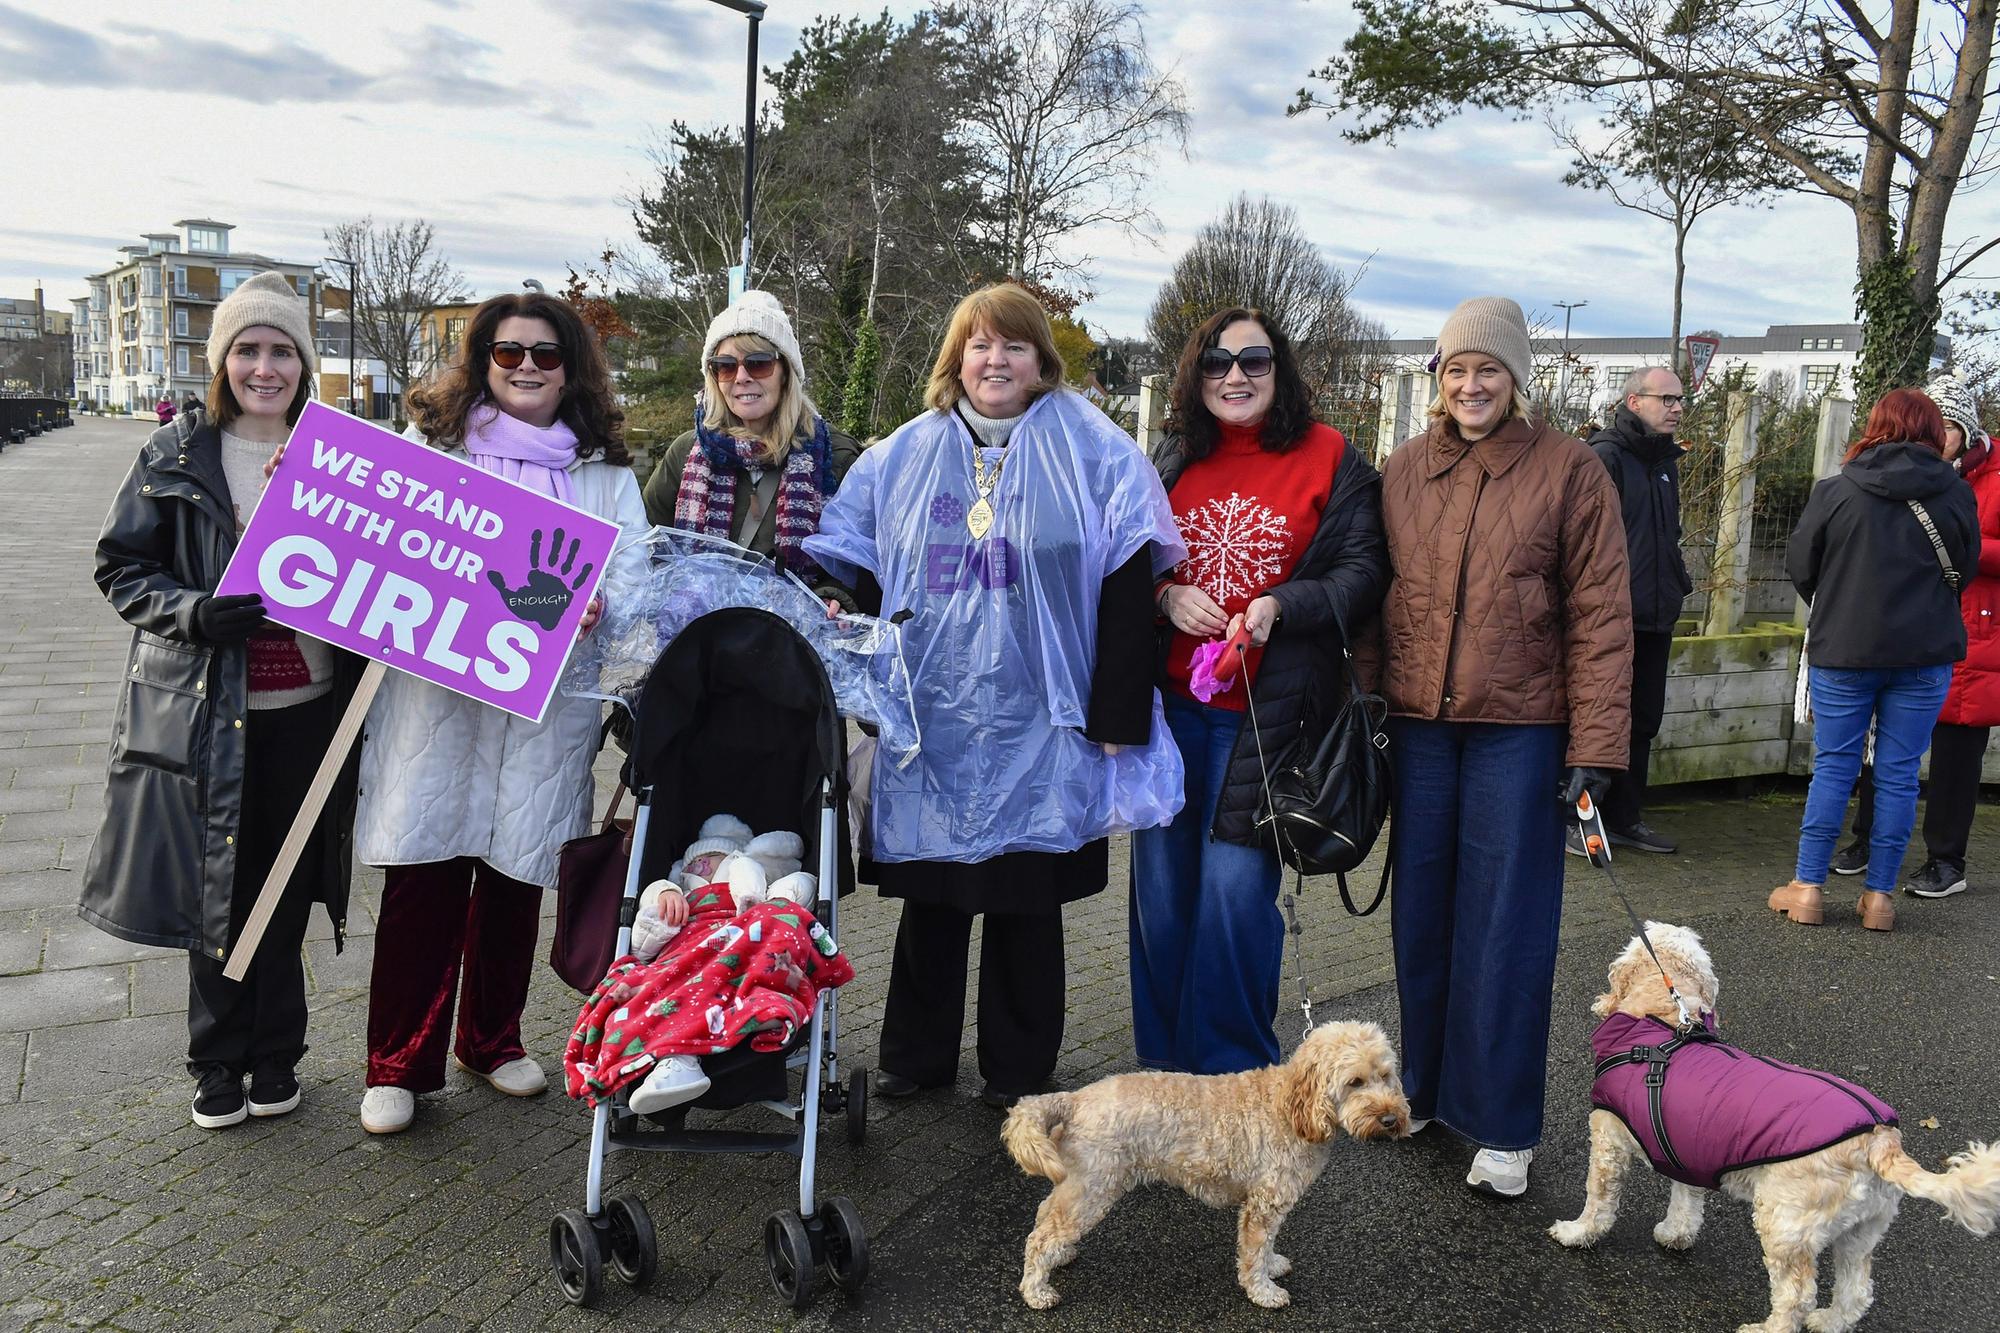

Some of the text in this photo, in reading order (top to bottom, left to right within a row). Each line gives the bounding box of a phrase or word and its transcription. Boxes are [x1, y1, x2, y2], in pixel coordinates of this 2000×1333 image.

[1692, 343, 1711, 357] GIVE
[311, 438, 504, 540] WE STAND
[291, 480, 484, 584] WITH OUR
[927, 537, 1021, 595] END
[257, 534, 540, 692] GIRLS
[509, 593, 568, 607] ENOUGH
